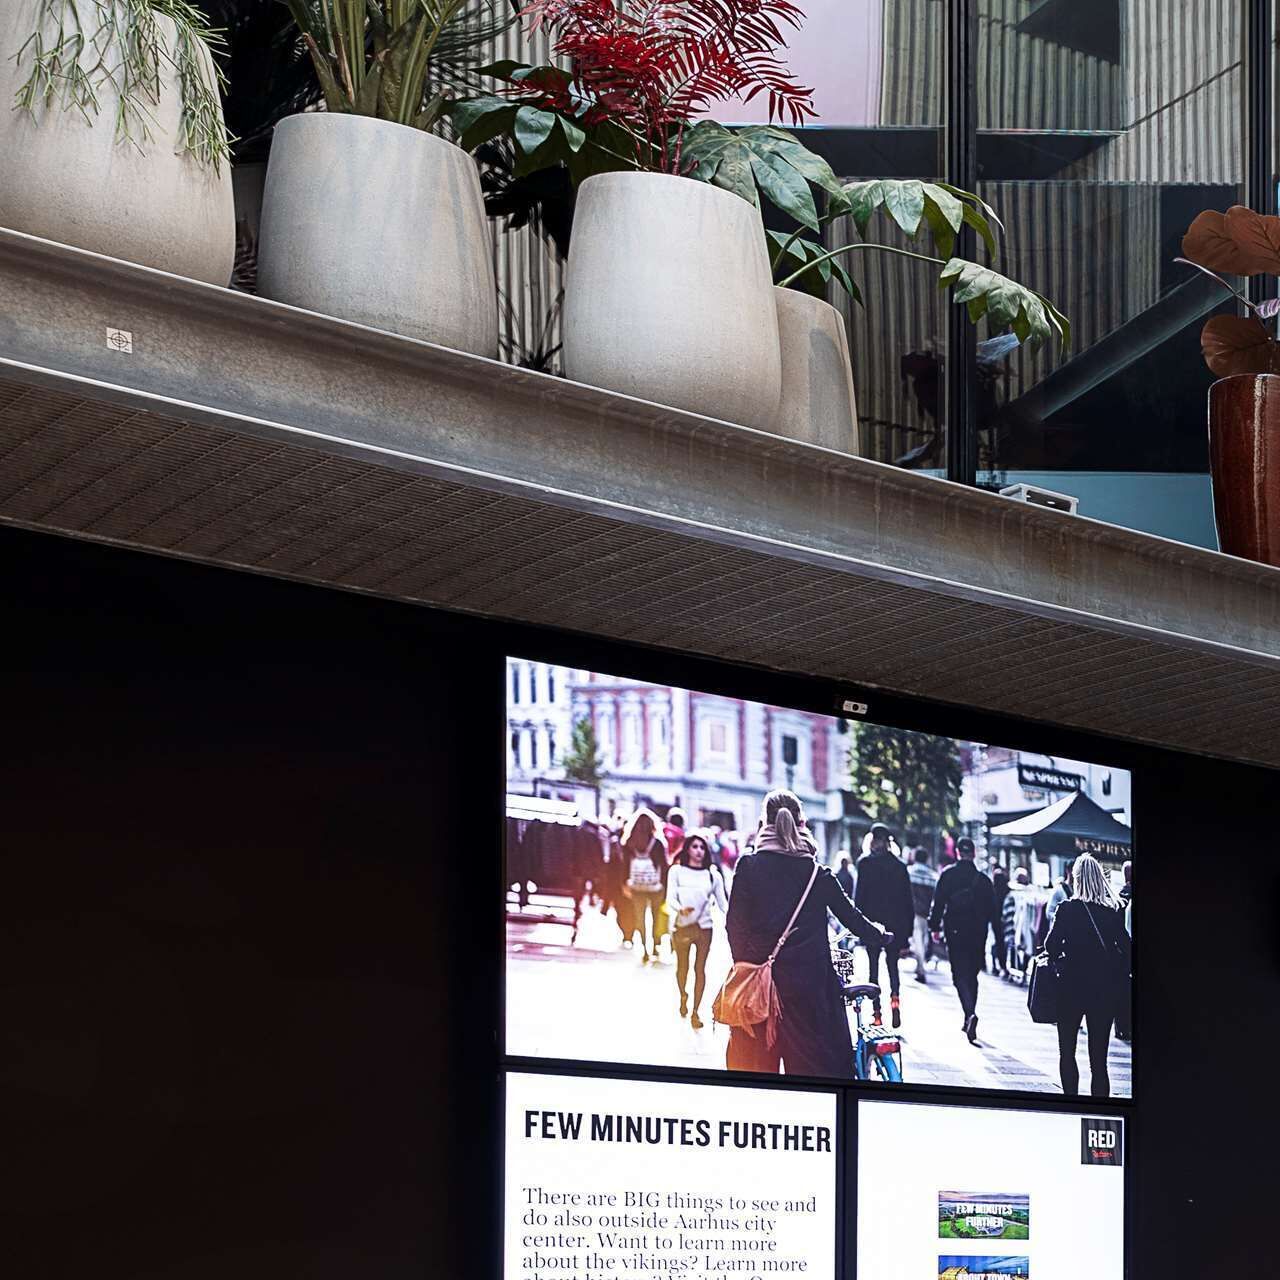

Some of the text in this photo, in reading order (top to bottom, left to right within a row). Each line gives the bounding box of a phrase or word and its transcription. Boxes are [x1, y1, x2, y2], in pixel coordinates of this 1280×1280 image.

[525, 1110, 832, 1152] FEW MINUTES FURTHER
[1088, 1129, 1116, 1149] RED
[522, 1187, 817, 1213] There are BIG things to see and
[523, 1208, 777, 1236] do also outside Aarhus city
[522, 1232, 777, 1251] center. Want to learn more
[522, 1251, 808, 1274] about the vikings? Learn more
